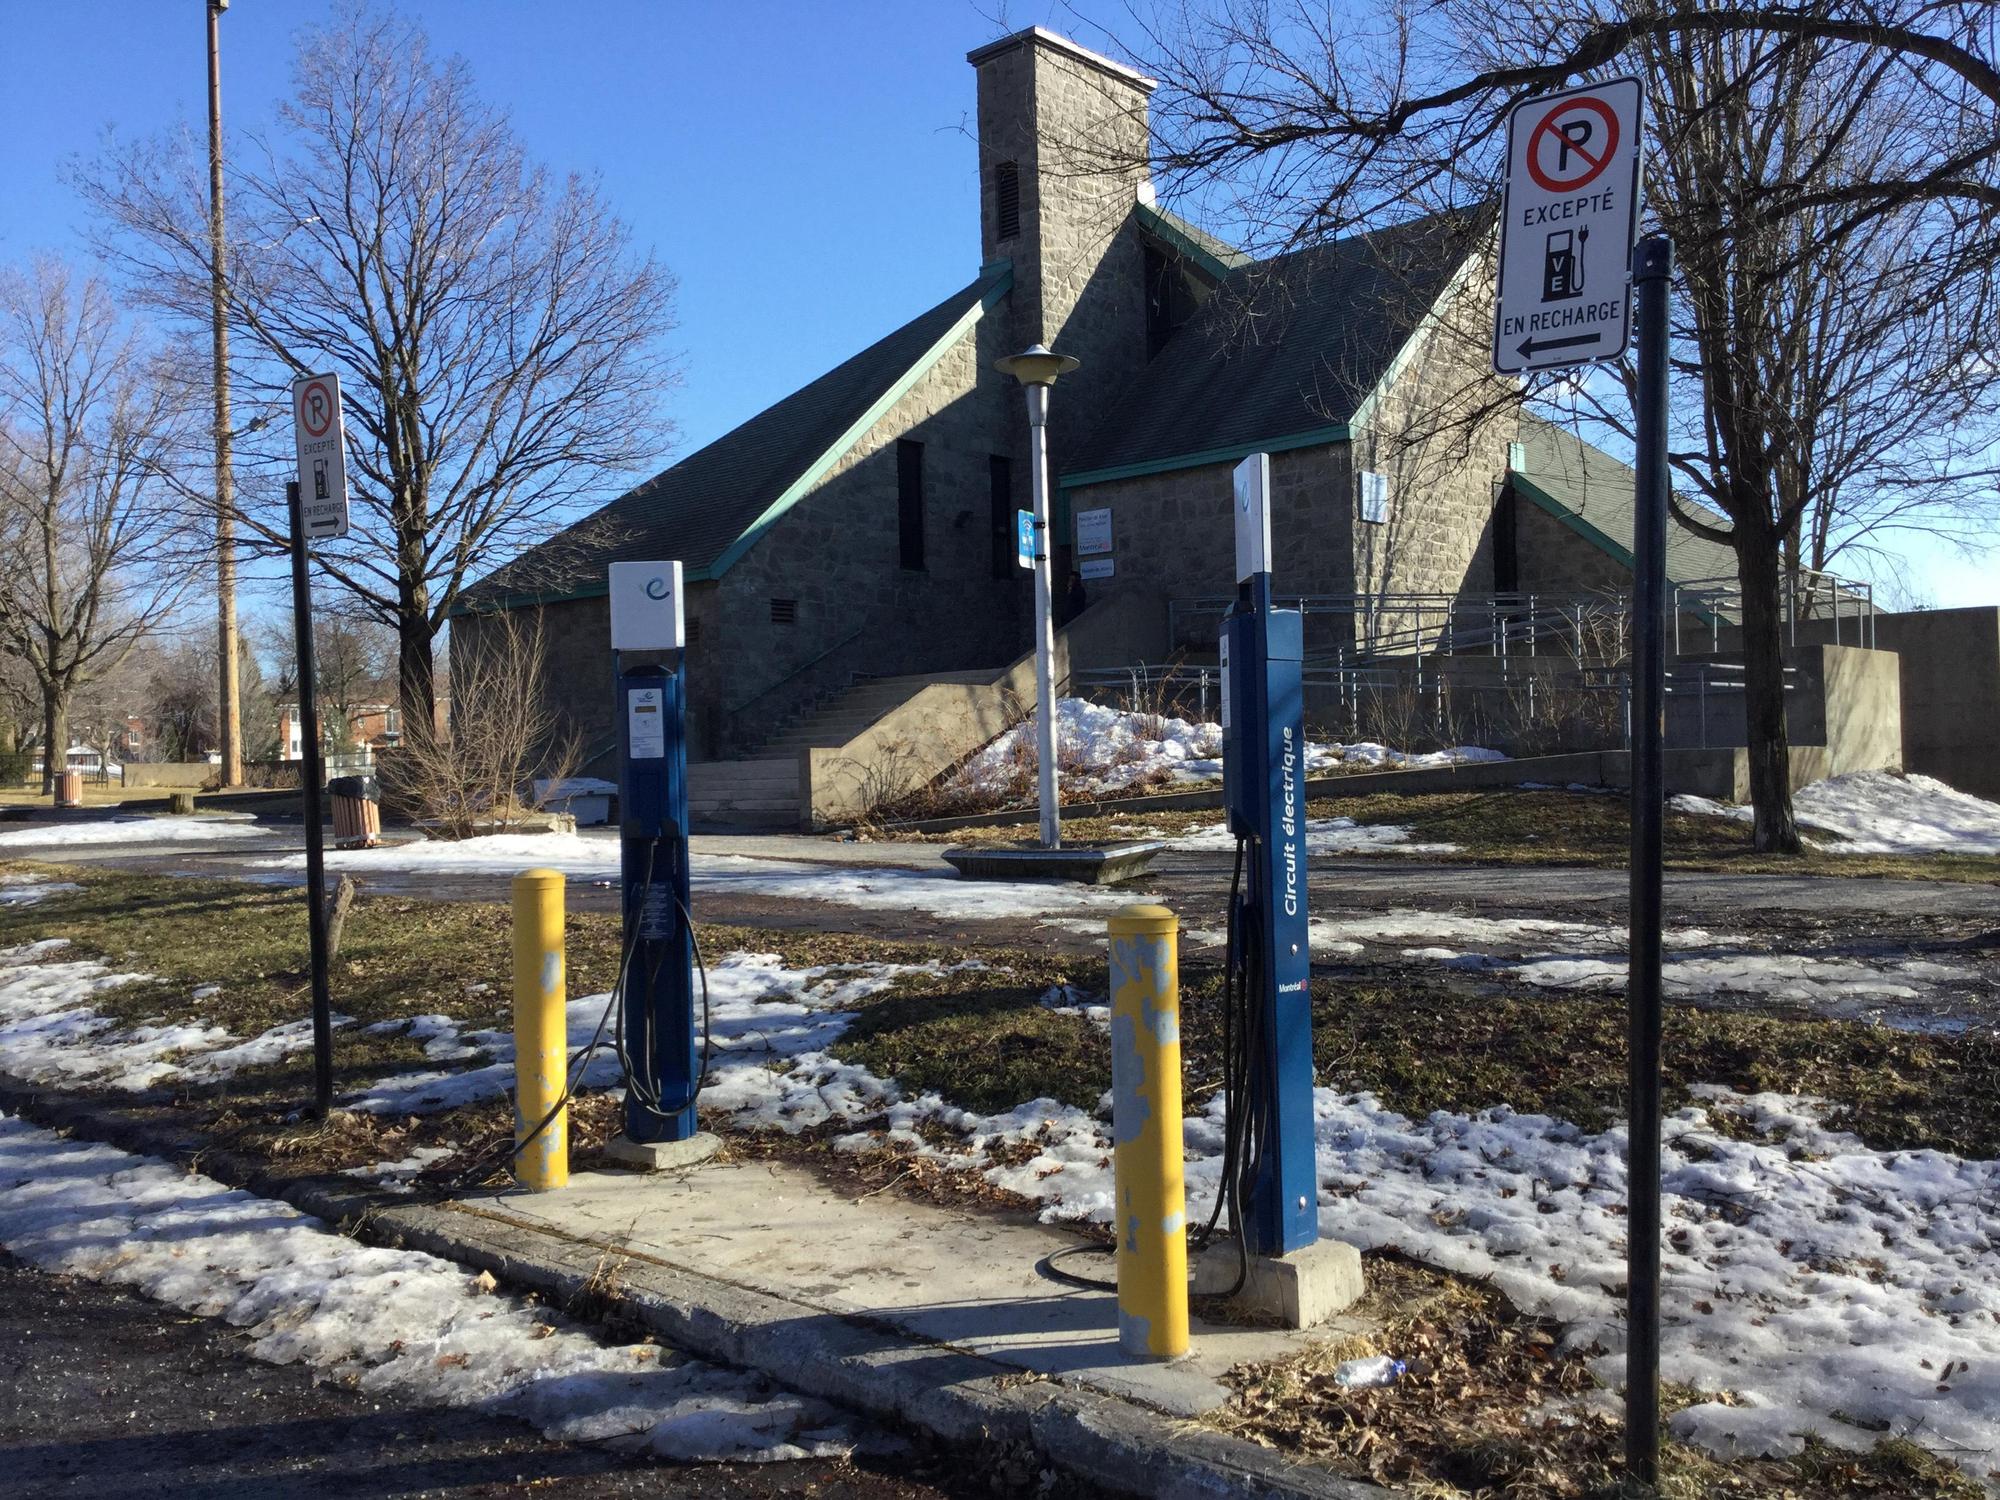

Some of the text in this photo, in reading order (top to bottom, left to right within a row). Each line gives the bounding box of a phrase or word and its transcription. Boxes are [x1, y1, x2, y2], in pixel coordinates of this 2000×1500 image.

[1558, 119, 1592, 172] P
[1523, 187, 1614, 227] EXCEPTÉ
[1503, 300, 1620, 336] EN RECHARGE
[311, 395, 323, 425] P
[304, 437, 336, 456] EXCEPTÉ
[303, 502, 344, 518] EN RECHARGE
[1281, 726, 1297, 917] Circuit électrique
